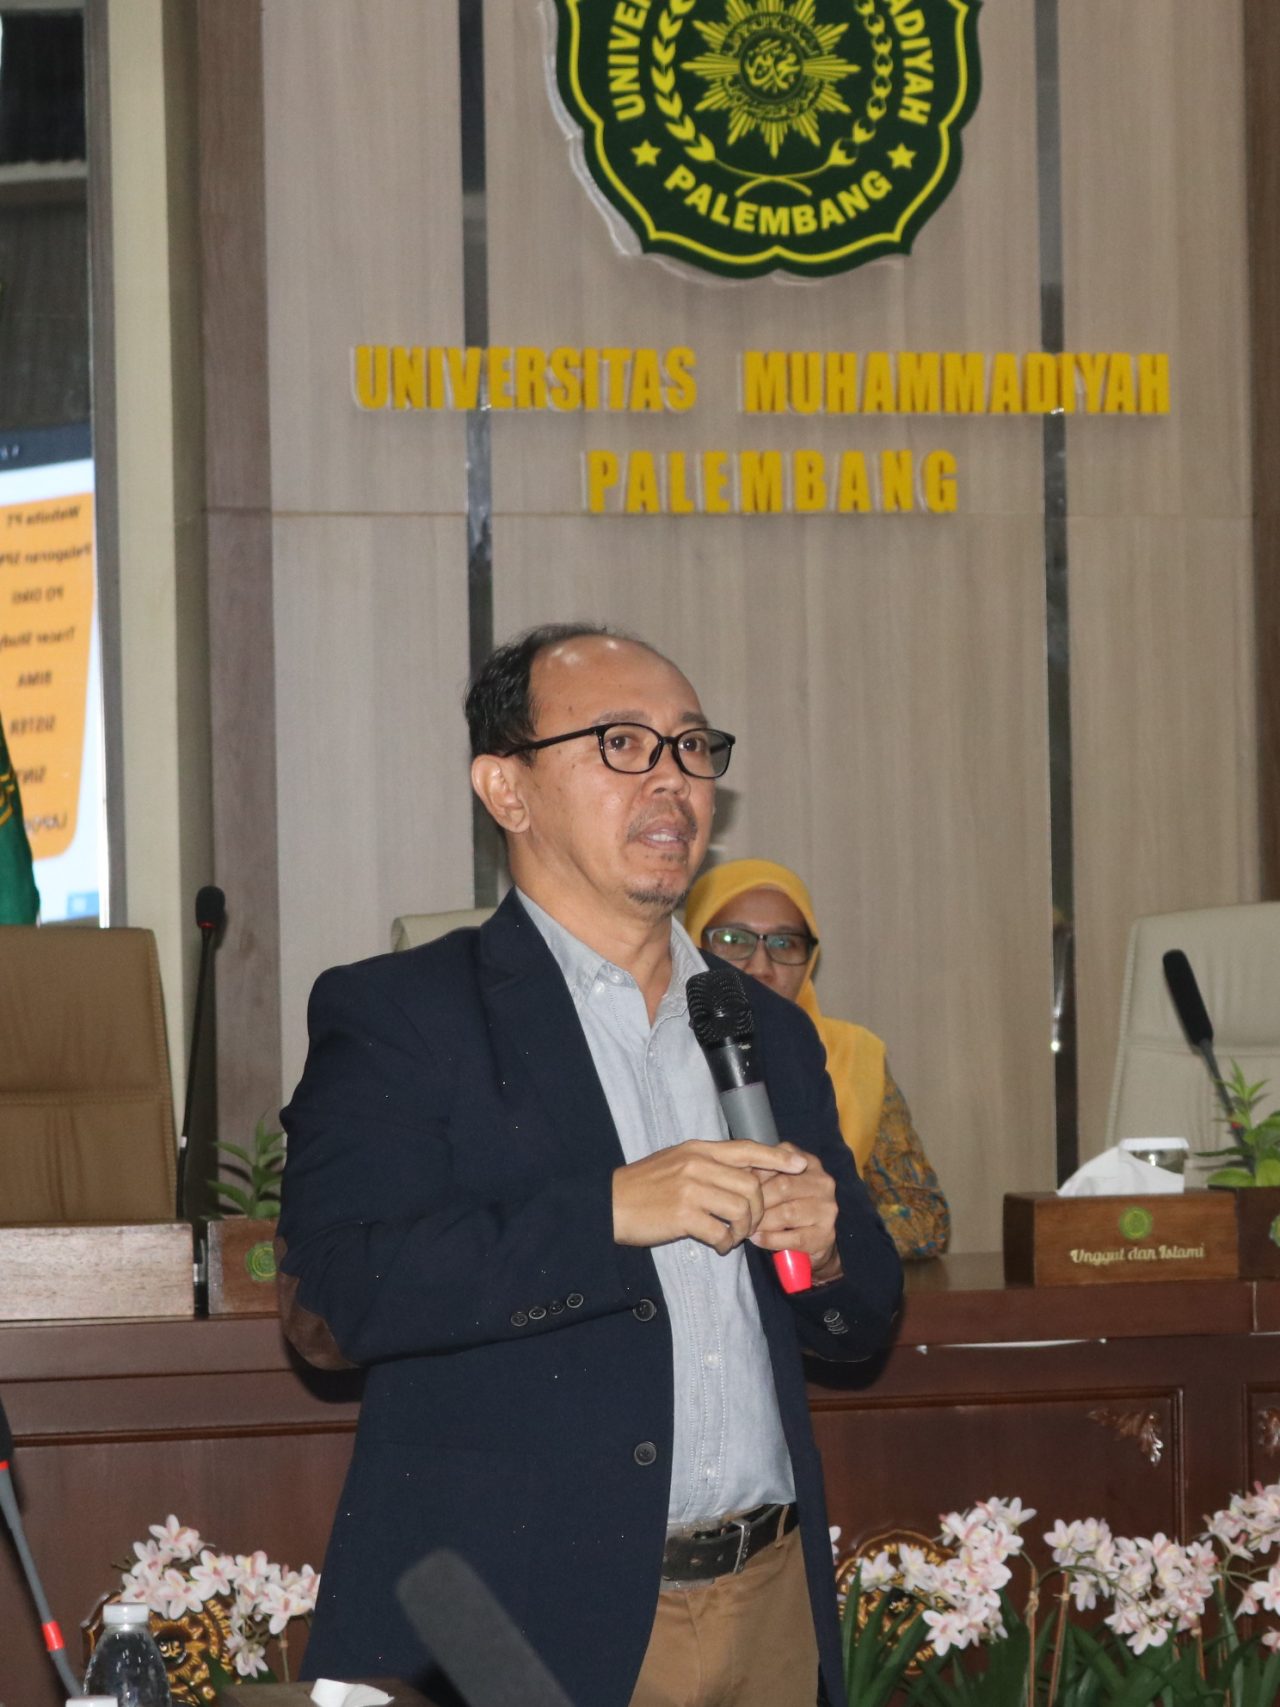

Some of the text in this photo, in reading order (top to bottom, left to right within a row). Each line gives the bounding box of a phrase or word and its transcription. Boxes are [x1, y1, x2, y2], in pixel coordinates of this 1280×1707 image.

[607, 0, 652, 122] UNIVE
[663, 164, 893, 237] PALEMBANG
[354, 345, 1171, 414] UNIVERSITAS MUHAMMADIYAH
[586, 449, 959, 514] PALEMBANG
[1070, 1243, 1205, 1265] Unggul dan Islami
